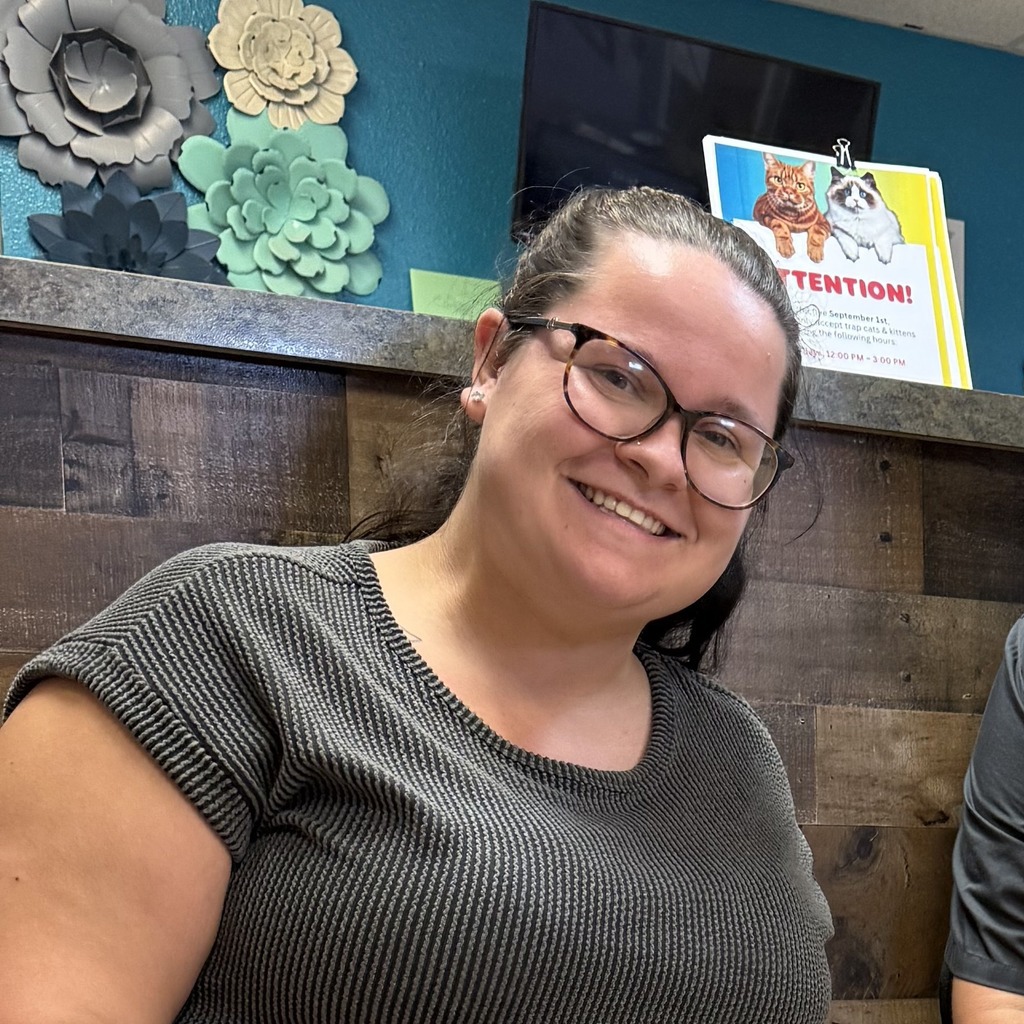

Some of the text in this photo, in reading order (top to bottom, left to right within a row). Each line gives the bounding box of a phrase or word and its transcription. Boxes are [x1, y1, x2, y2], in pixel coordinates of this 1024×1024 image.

[777, 267, 913, 304] TTENTION!
[829, 309, 874, 323] September
[818, 329, 832, 338] the
[833, 330, 871, 345] following
[844, 322, 862, 332] trap
[863, 325, 880, 334] cats
[881, 326, 888, 335] &
[889, 327, 916, 338] kittens
[850, 353, 865, 362] PM
[893, 358, 906, 367] PM
